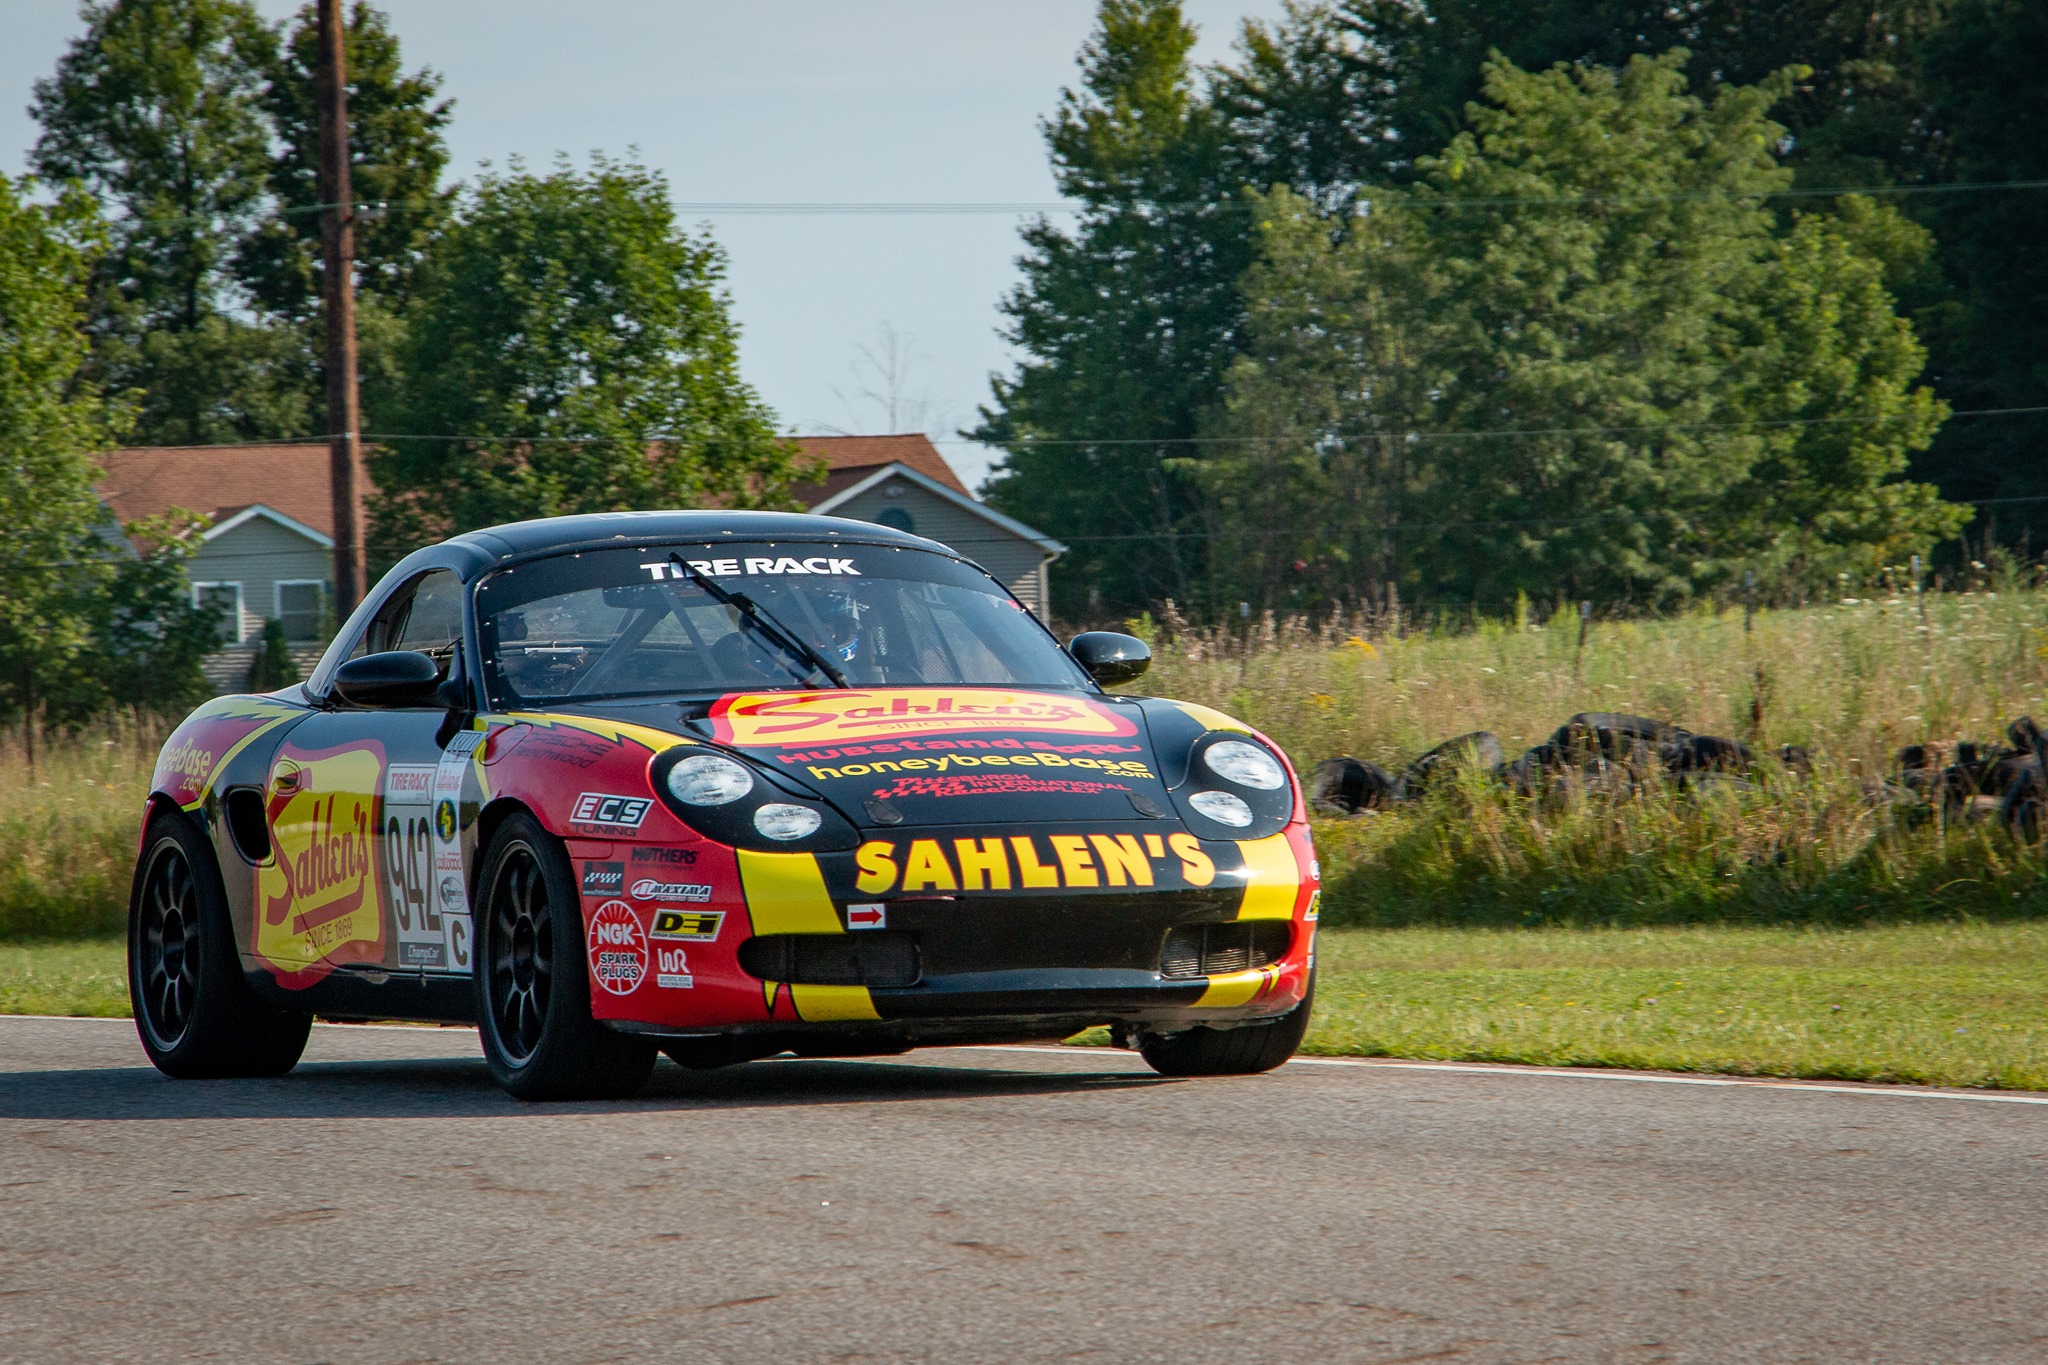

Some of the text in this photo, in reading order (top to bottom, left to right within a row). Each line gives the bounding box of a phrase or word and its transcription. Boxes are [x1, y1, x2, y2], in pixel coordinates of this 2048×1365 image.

[640, 557, 862, 580] TIRE RACK
[735, 693, 1088, 735] Sahlen's
[877, 720, 958, 731] SINCE
[807, 752, 1150, 781] honeybeeBase
[1104, 770, 1156, 779] .com
[970, 779, 1132, 791] INTERNATIONAL
[577, 797, 646, 823] ECS
[572, 823, 637, 838] TUNING
[265, 767, 369, 927] Sahlen's
[631, 847, 699, 865] MOTHERS
[388, 815, 442, 932] 942
[854, 833, 1216, 894] SAHLEN'S
[650, 883, 710, 896] MAXIMA
[305, 924, 333, 951] SINCE
[452, 920, 468, 966] C
[597, 923, 636, 946] NGK
[600, 953, 637, 966] SPARK
[601, 966, 638, 979] PLUGS
